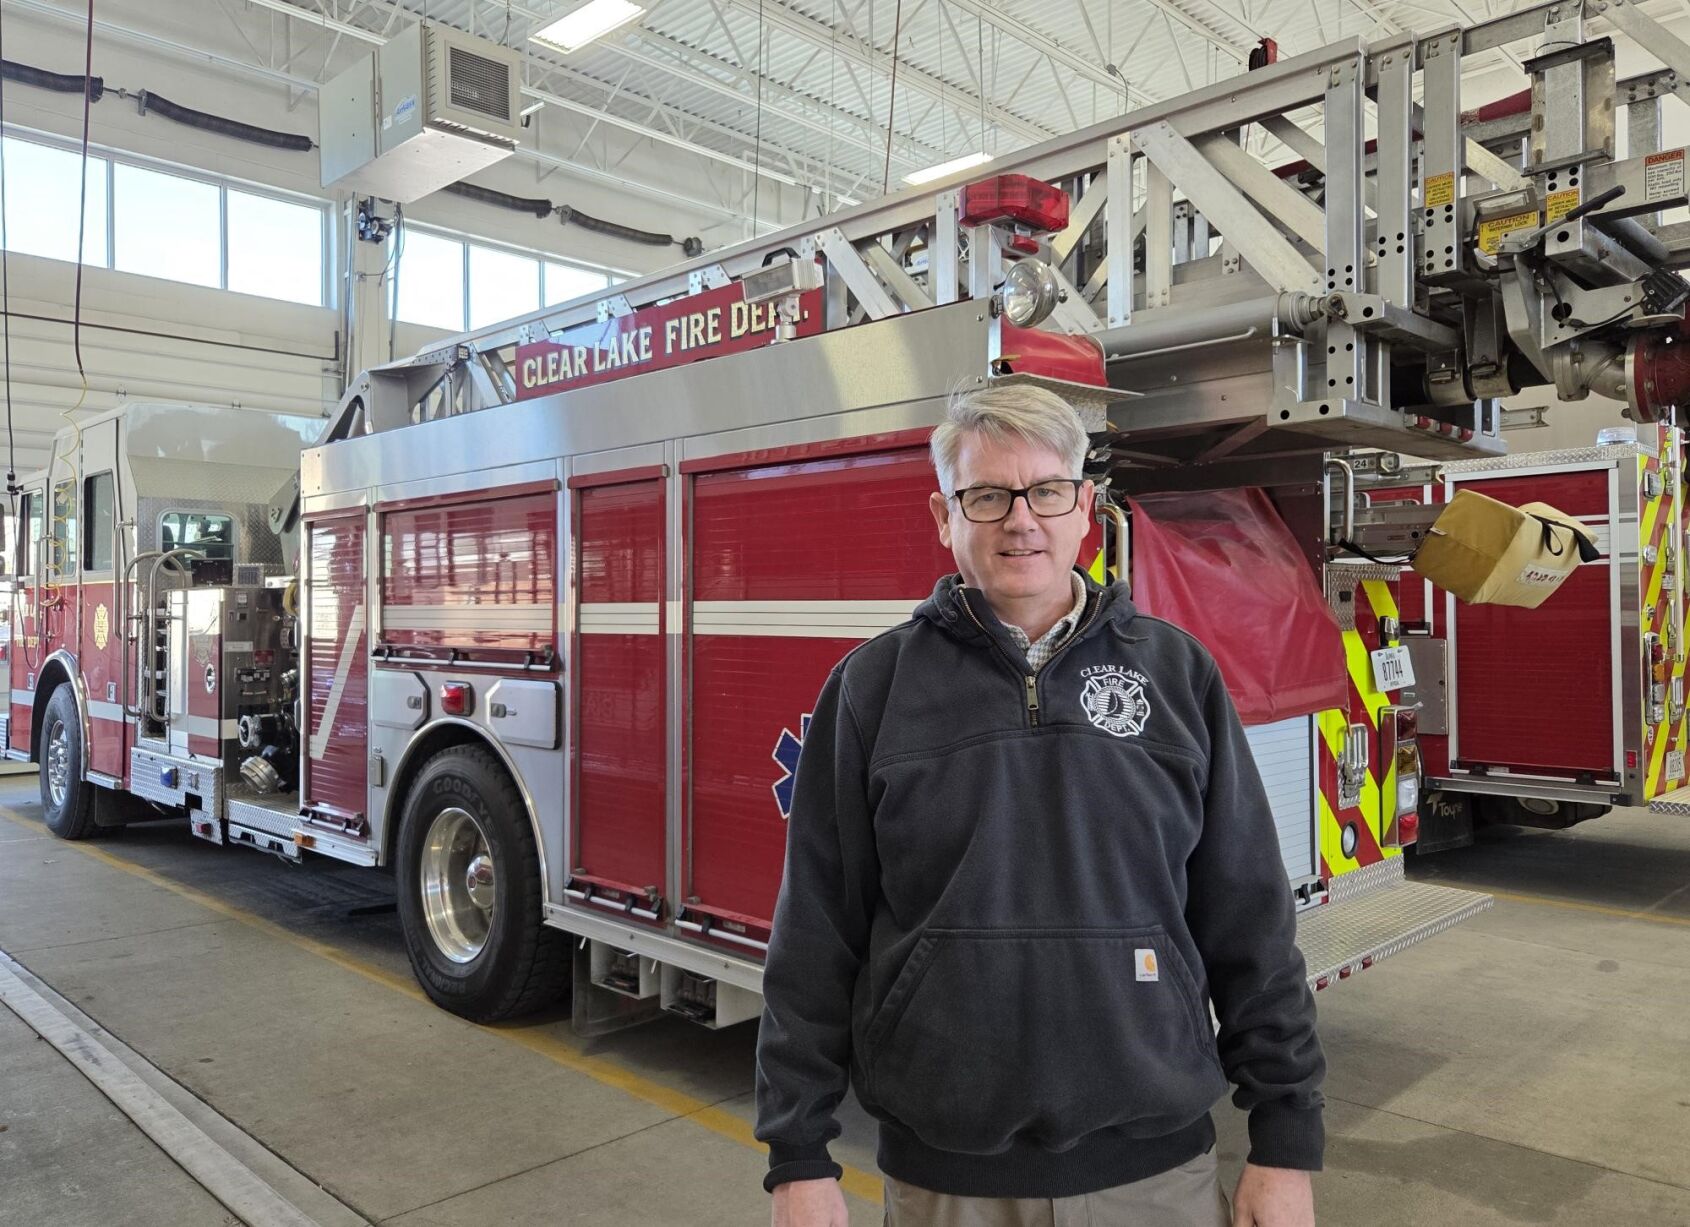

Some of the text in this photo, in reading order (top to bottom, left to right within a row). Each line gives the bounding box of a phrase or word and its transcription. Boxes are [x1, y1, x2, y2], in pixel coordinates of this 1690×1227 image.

[1648, 151, 1682, 164] DANGER
[1488, 214, 1530, 228] CAUTION
[523, 298, 809, 389] CLEAR LAKE FIRE DEP.
[1354, 460, 1367, 468] 24
[1080, 665, 1150, 687] CLEAR LAKE
[1103, 677, 1126, 688] FIRE
